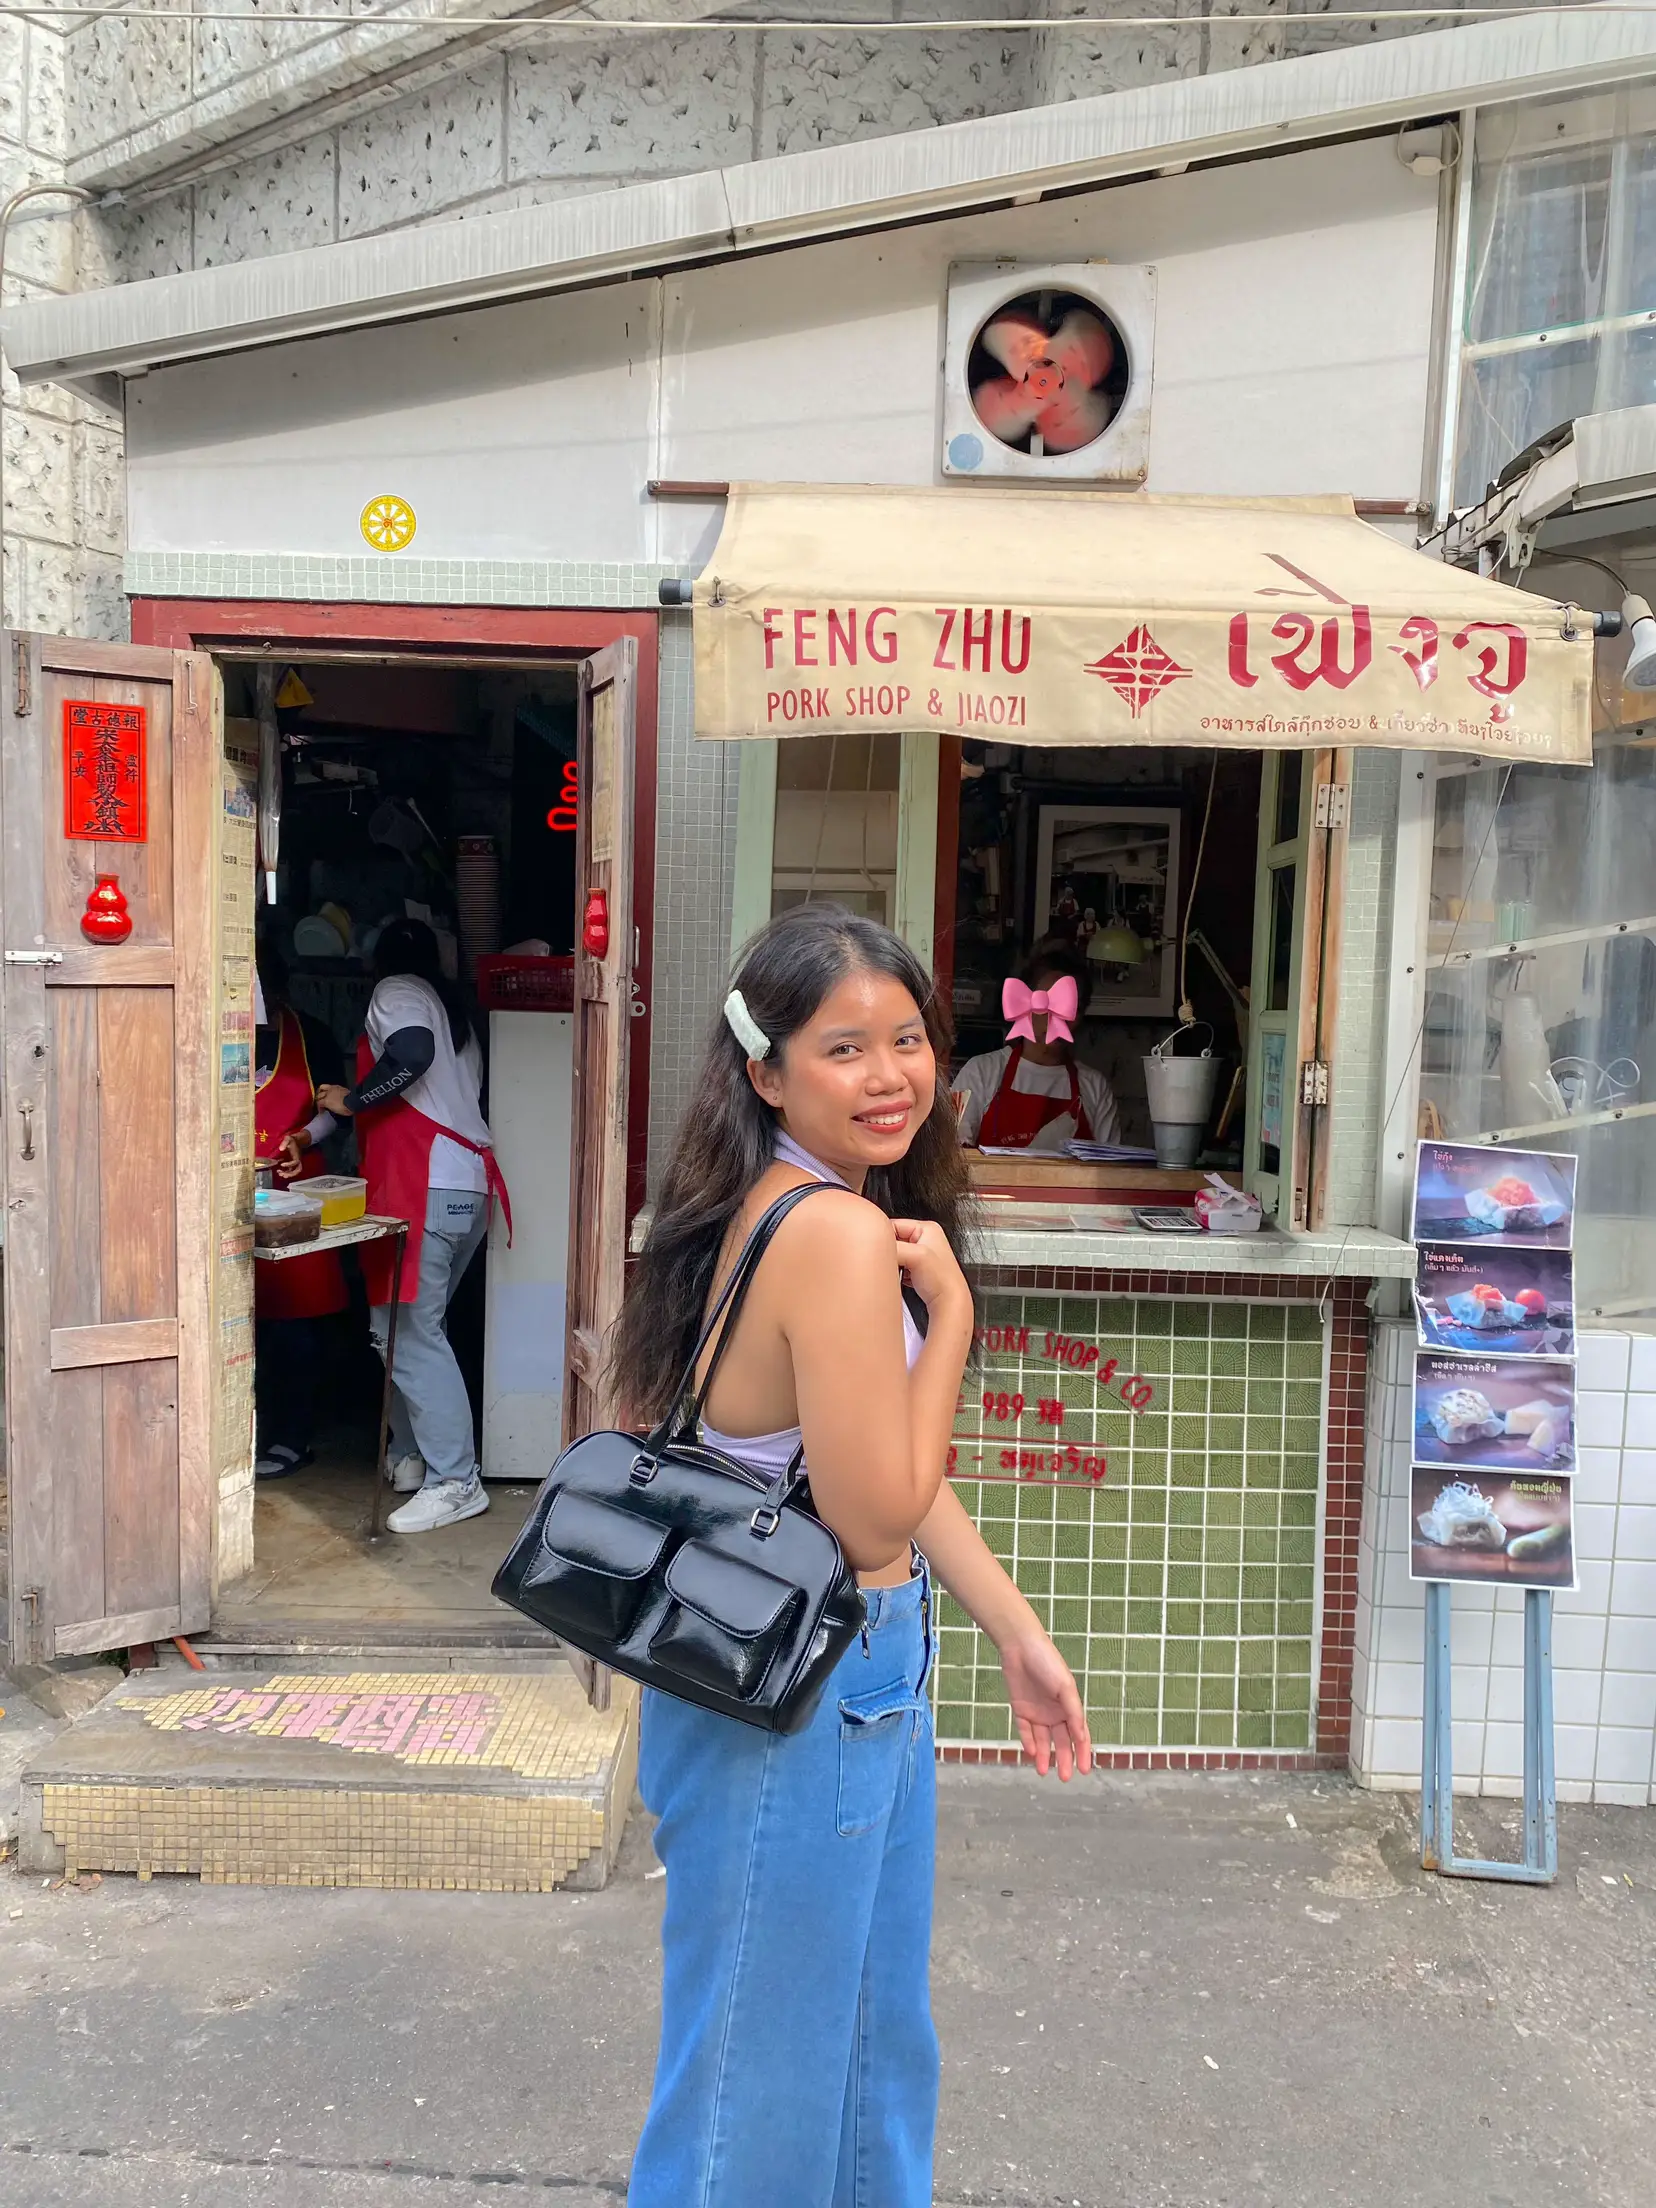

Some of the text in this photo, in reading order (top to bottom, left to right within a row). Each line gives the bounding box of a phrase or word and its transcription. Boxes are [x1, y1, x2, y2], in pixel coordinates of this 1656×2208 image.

[763, 607, 1031, 674] FENG ZHU
[766, 686, 1028, 728] PORK SHOP & JIAOZI
[1369, 714, 1379, 731] &
[360, 1067, 413, 1104] THELION
[1041, 1331, 1099, 1370] SHOP
[1097, 1358, 1119, 1385] &
[982, 1391, 1025, 1422] 989
